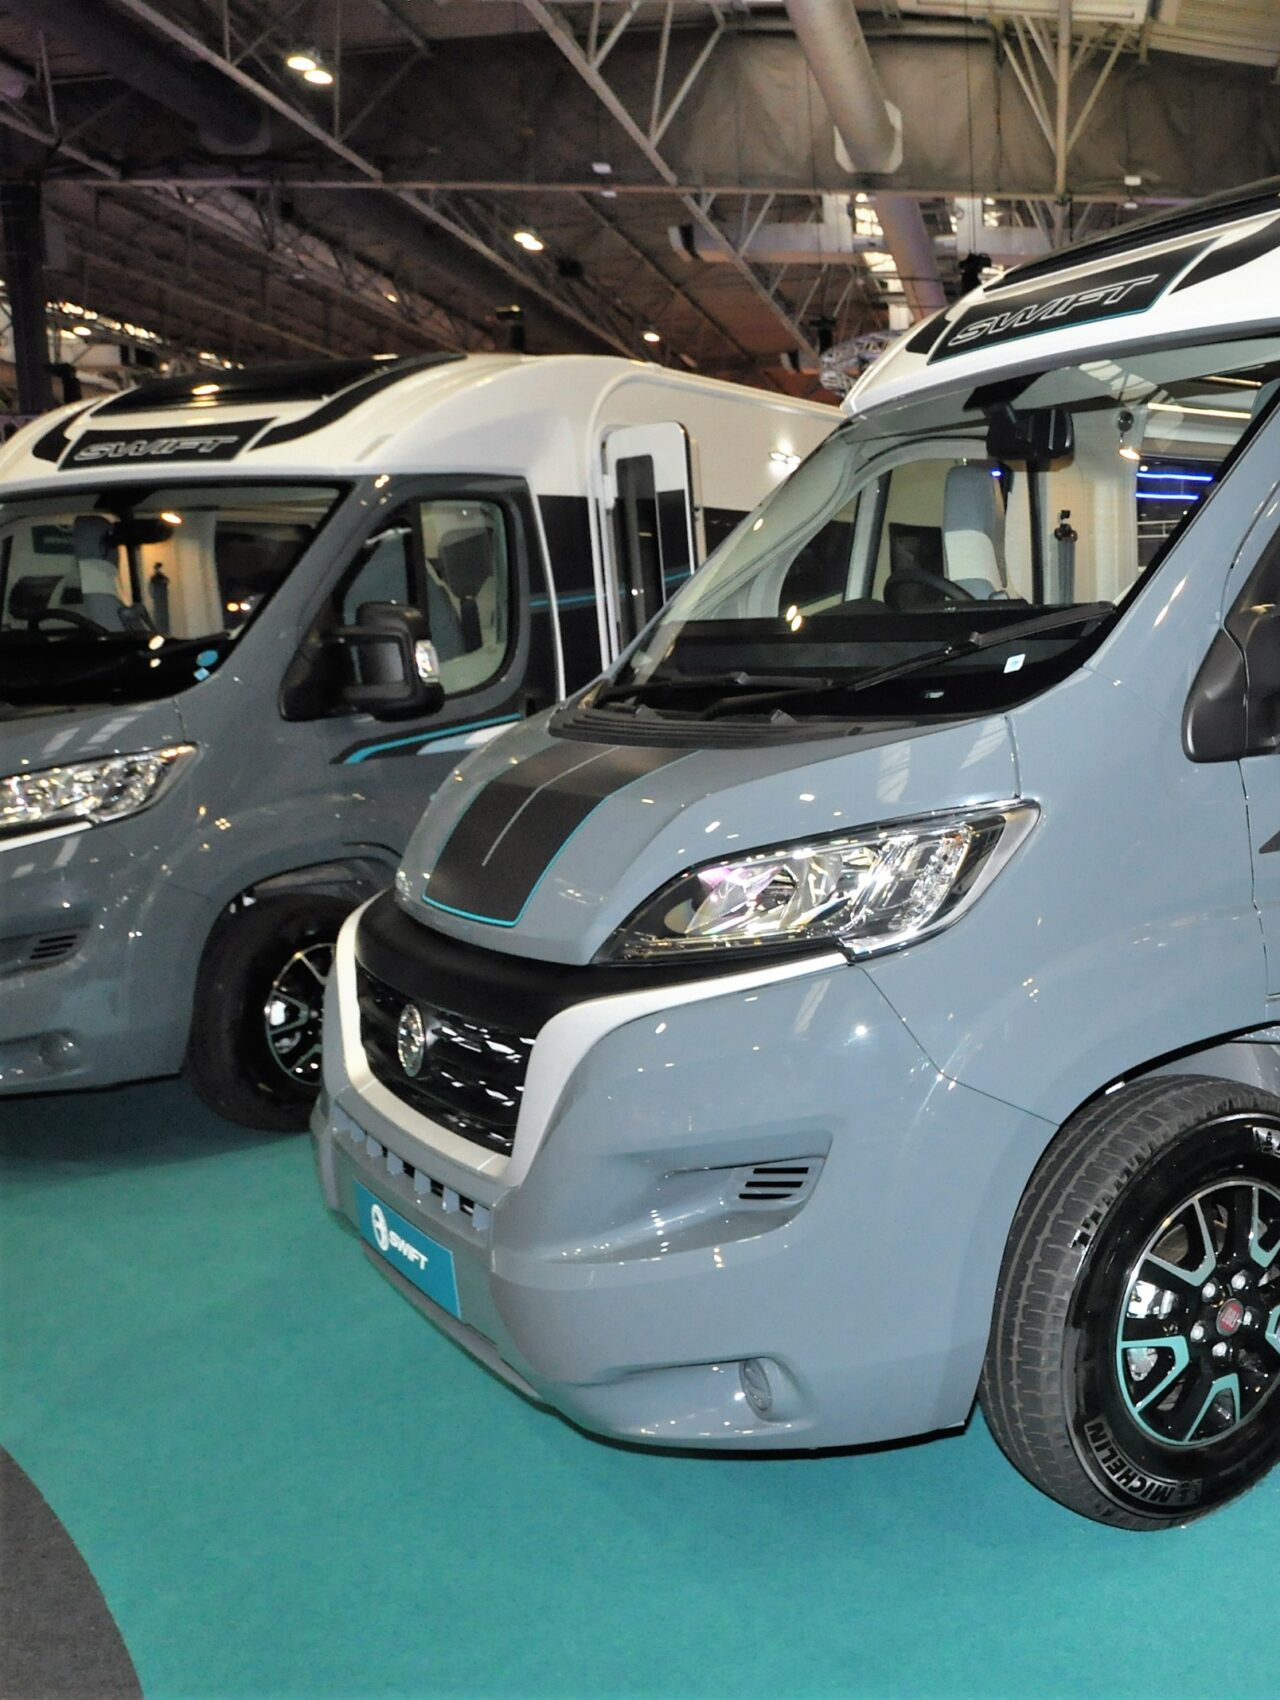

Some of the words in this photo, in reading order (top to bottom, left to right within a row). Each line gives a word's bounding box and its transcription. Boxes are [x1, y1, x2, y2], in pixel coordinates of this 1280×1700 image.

[947, 273, 1160, 347] SWIFT
[73, 434, 240, 462] SWIFT
[388, 1230, 429, 1271] SWIFT
[1085, 1420, 1177, 1504] MICHELIN
